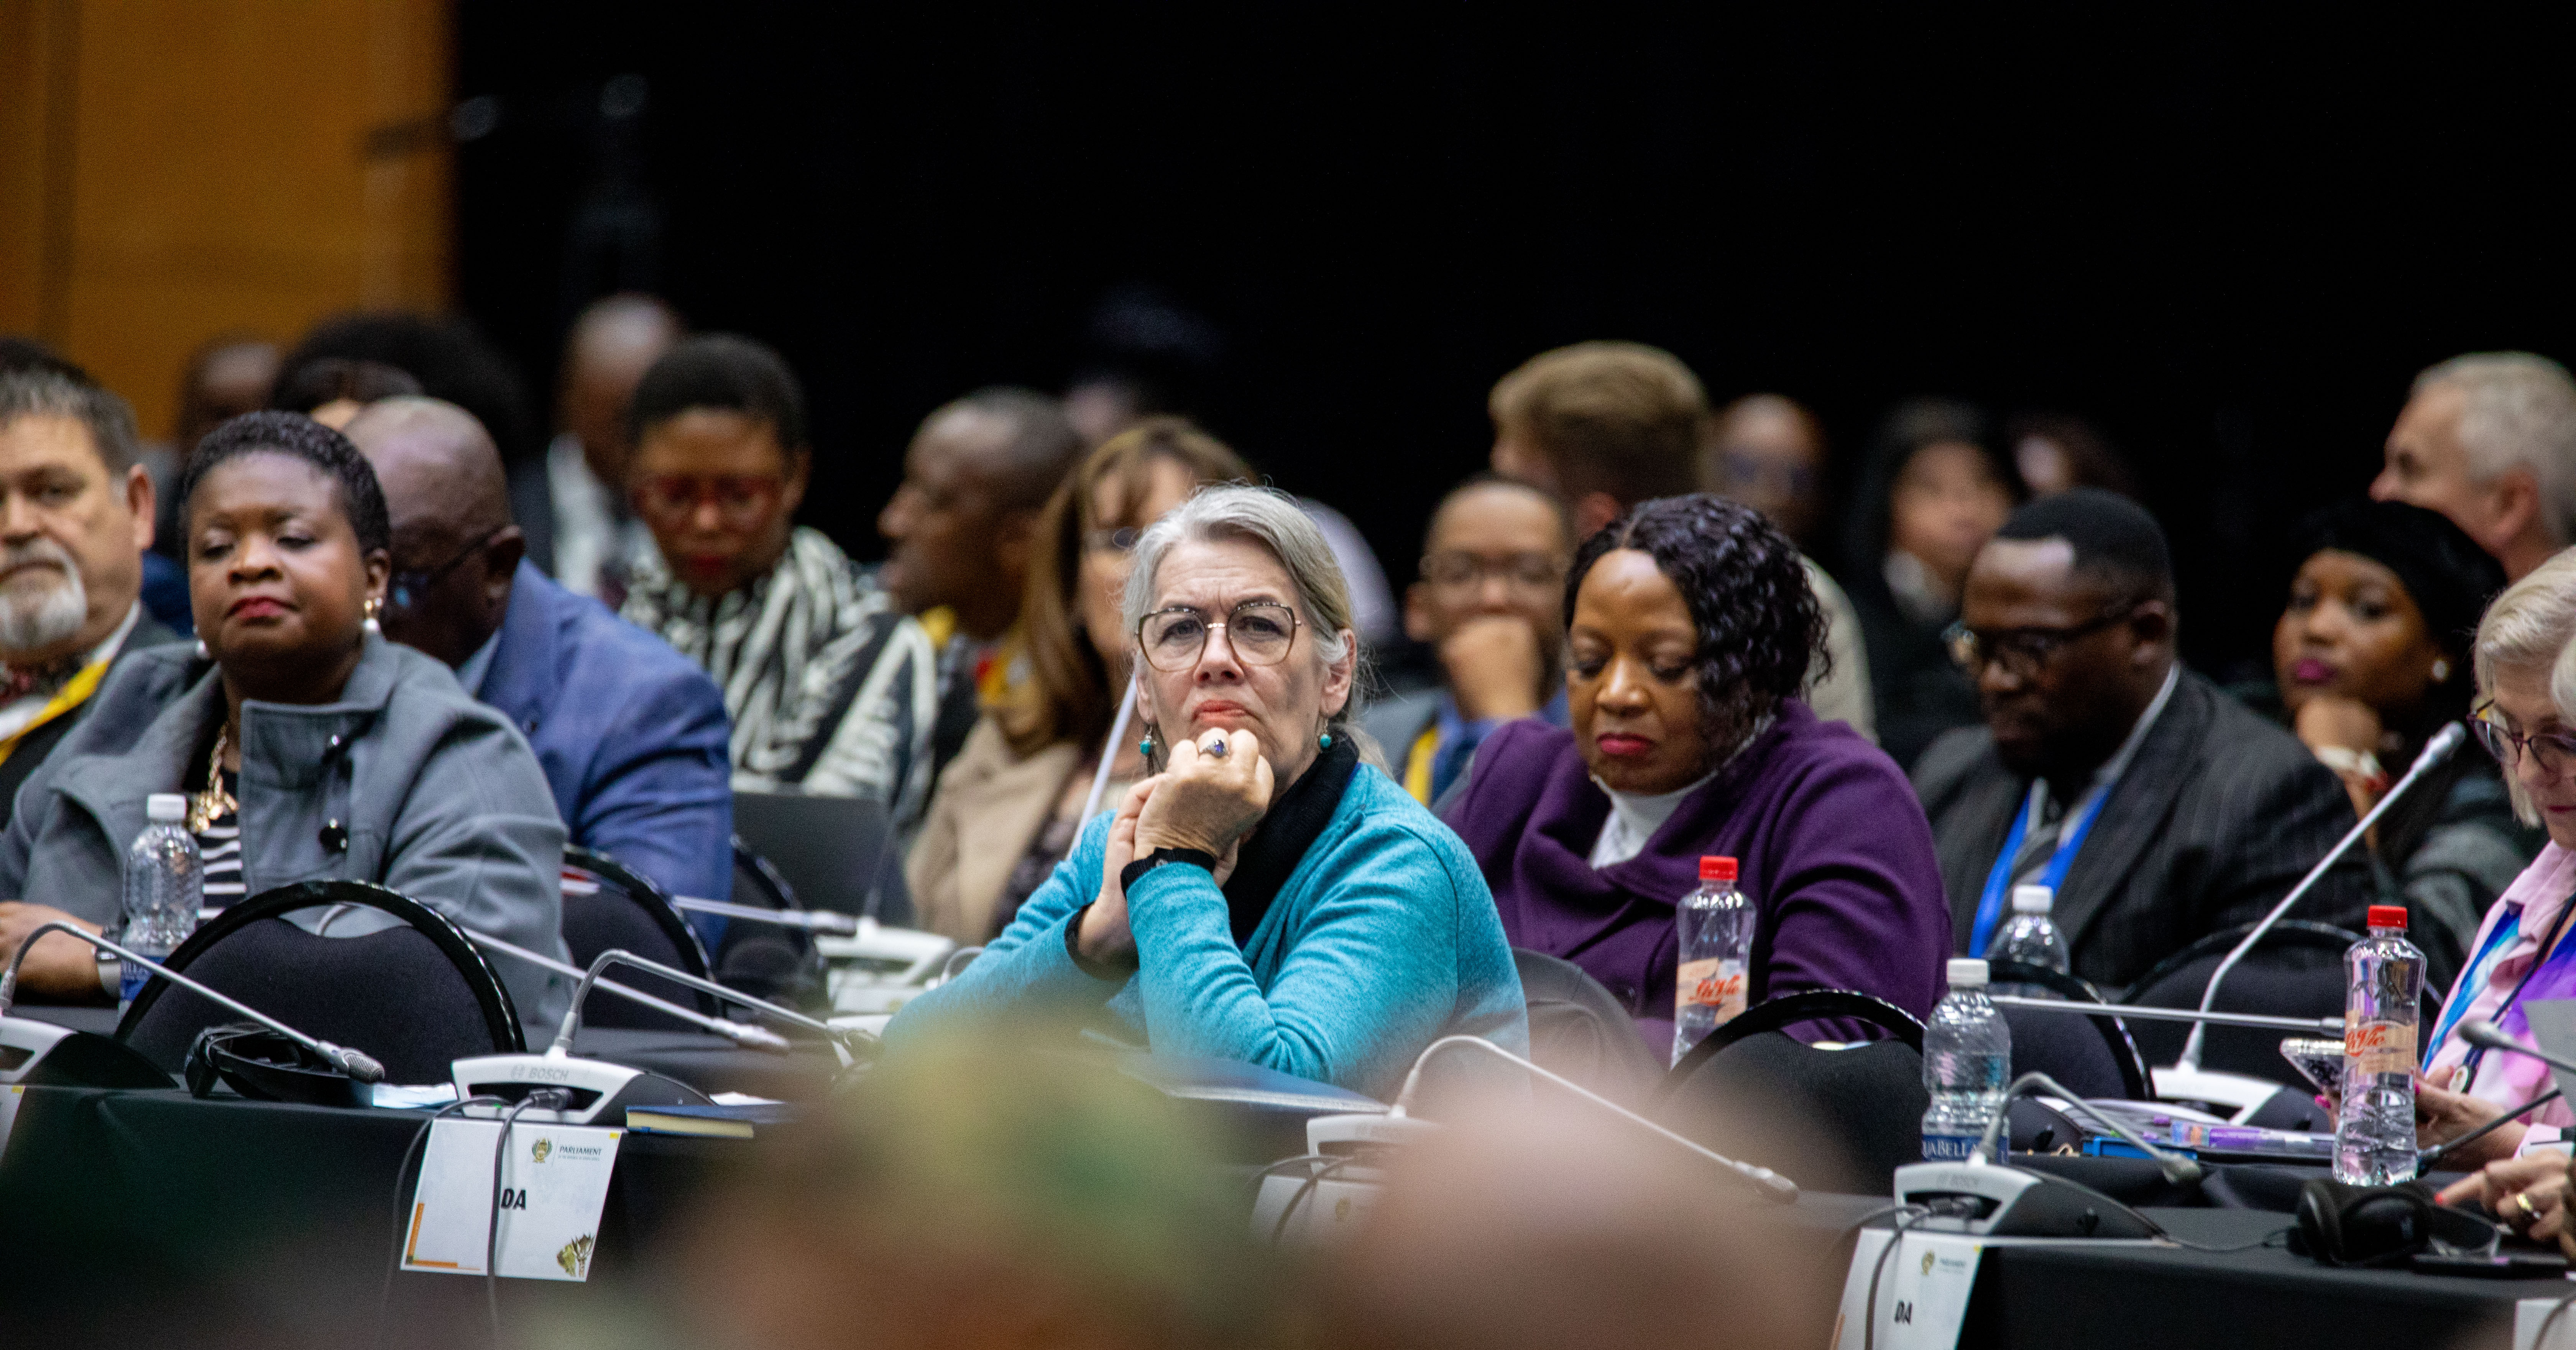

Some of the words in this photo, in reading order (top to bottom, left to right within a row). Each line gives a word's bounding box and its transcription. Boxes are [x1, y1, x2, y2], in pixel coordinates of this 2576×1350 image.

[528, 1066, 570, 1082] BOSCH
[559, 1145, 602, 1156] PARLIAMENT
[501, 1188, 526, 1210] DA
[1894, 1300, 1913, 1326] DA
